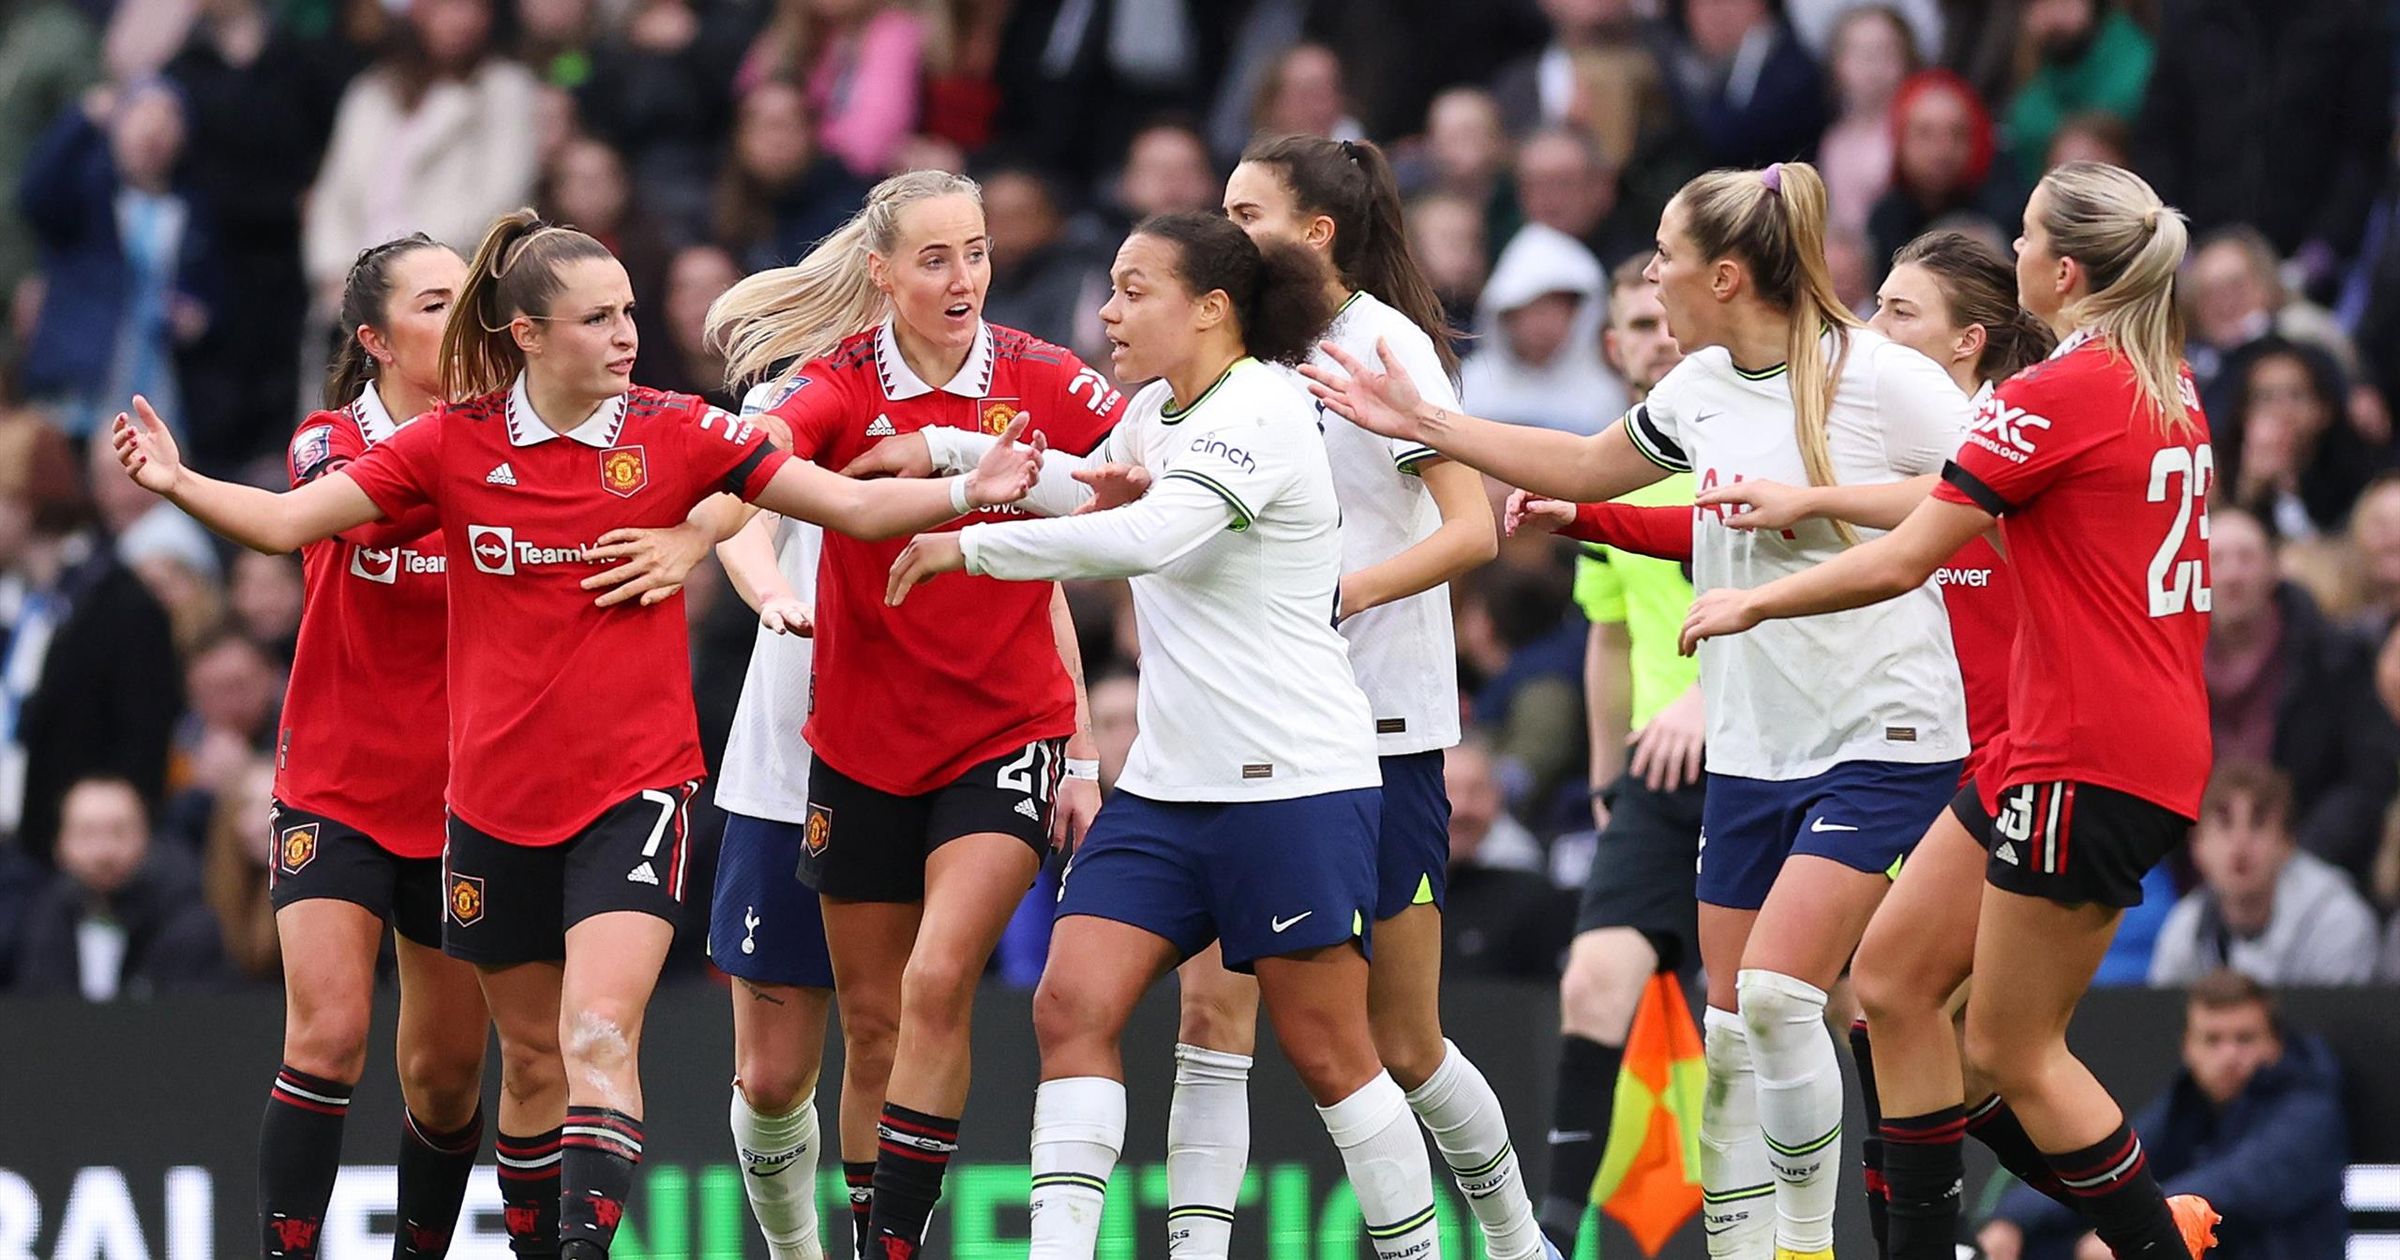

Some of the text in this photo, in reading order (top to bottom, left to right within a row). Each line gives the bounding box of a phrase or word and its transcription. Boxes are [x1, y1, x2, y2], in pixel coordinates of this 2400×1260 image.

[1190, 432, 1257, 475] cinch
[1935, 567, 1992, 587] ewer
[997, 741, 1052, 803] 21
[642, 789, 675, 857] 7
[742, 1143, 808, 1164] SPURS
[1380, 1239, 1431, 1260] SPURS
